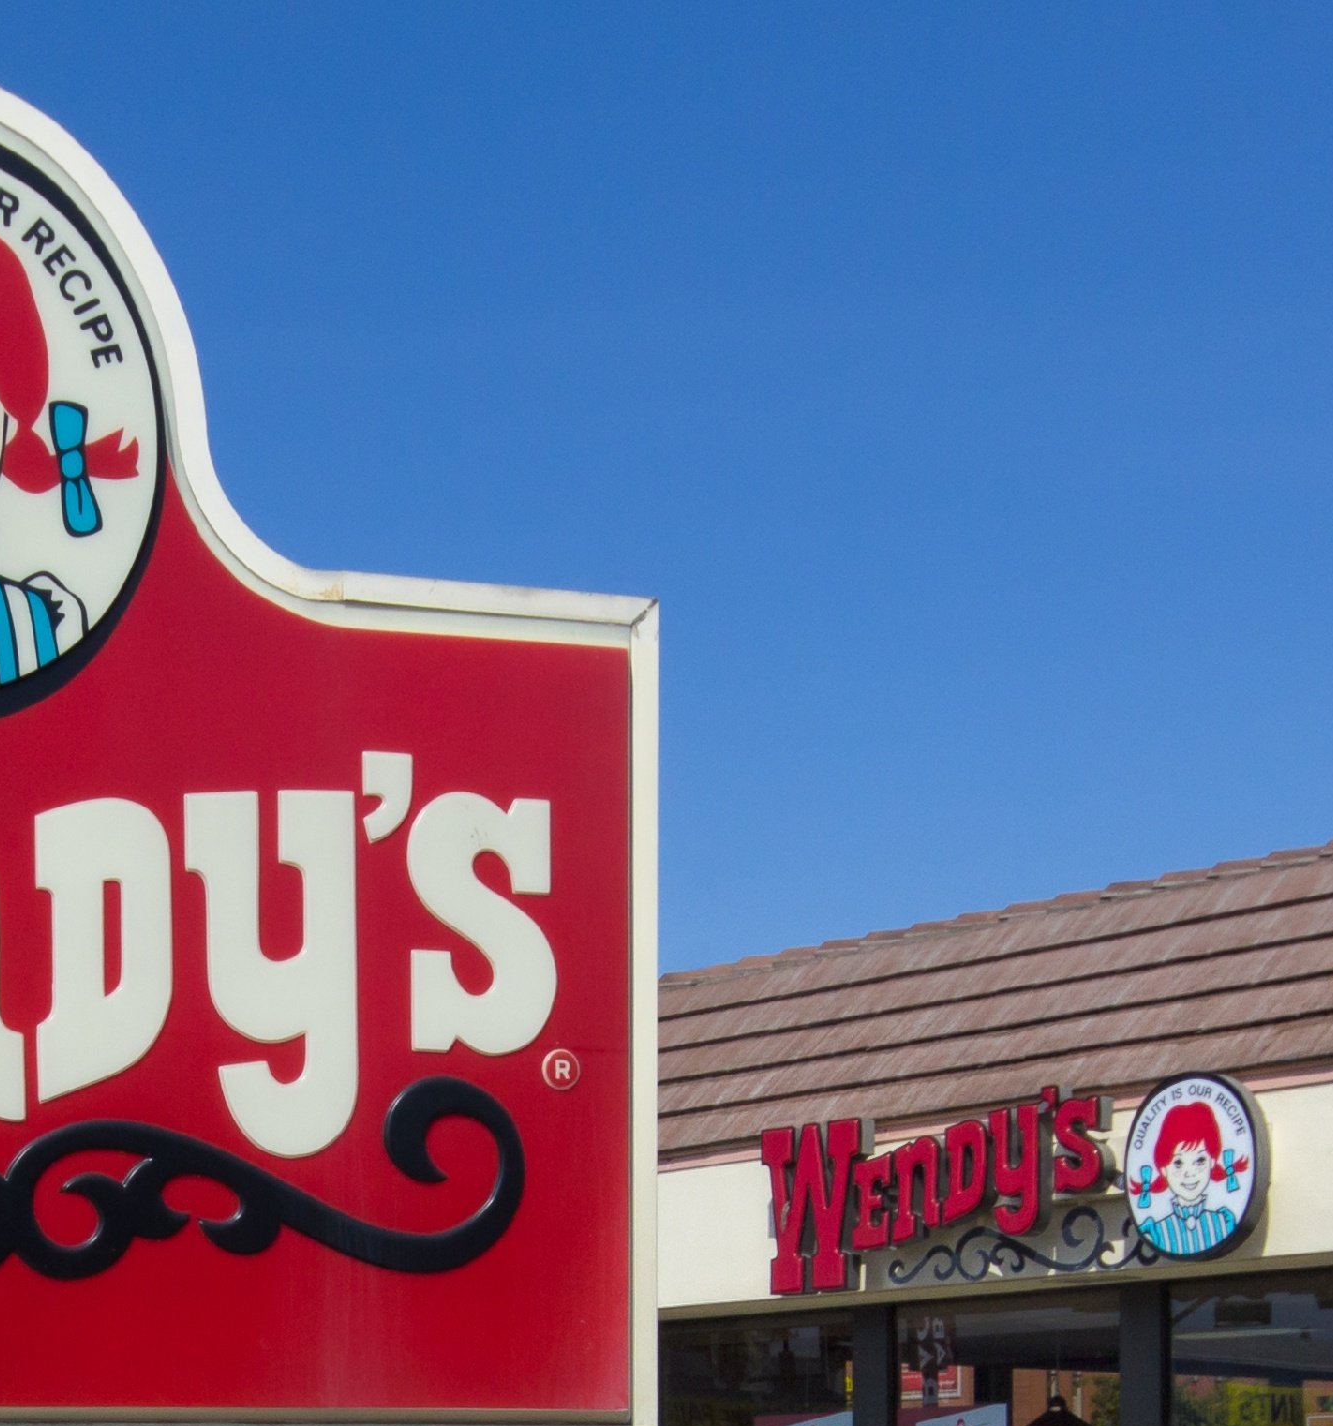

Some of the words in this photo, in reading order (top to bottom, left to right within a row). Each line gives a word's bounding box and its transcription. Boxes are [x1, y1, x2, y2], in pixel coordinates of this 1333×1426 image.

[22, 217, 123, 370] RECIPE
[1134, 1095, 1168, 1150] QUALITY
[1171, 1087, 1183, 1100] IS
[1187, 1084, 1213, 1099] OUR
[1215, 1092, 1246, 1136] RECIPE
